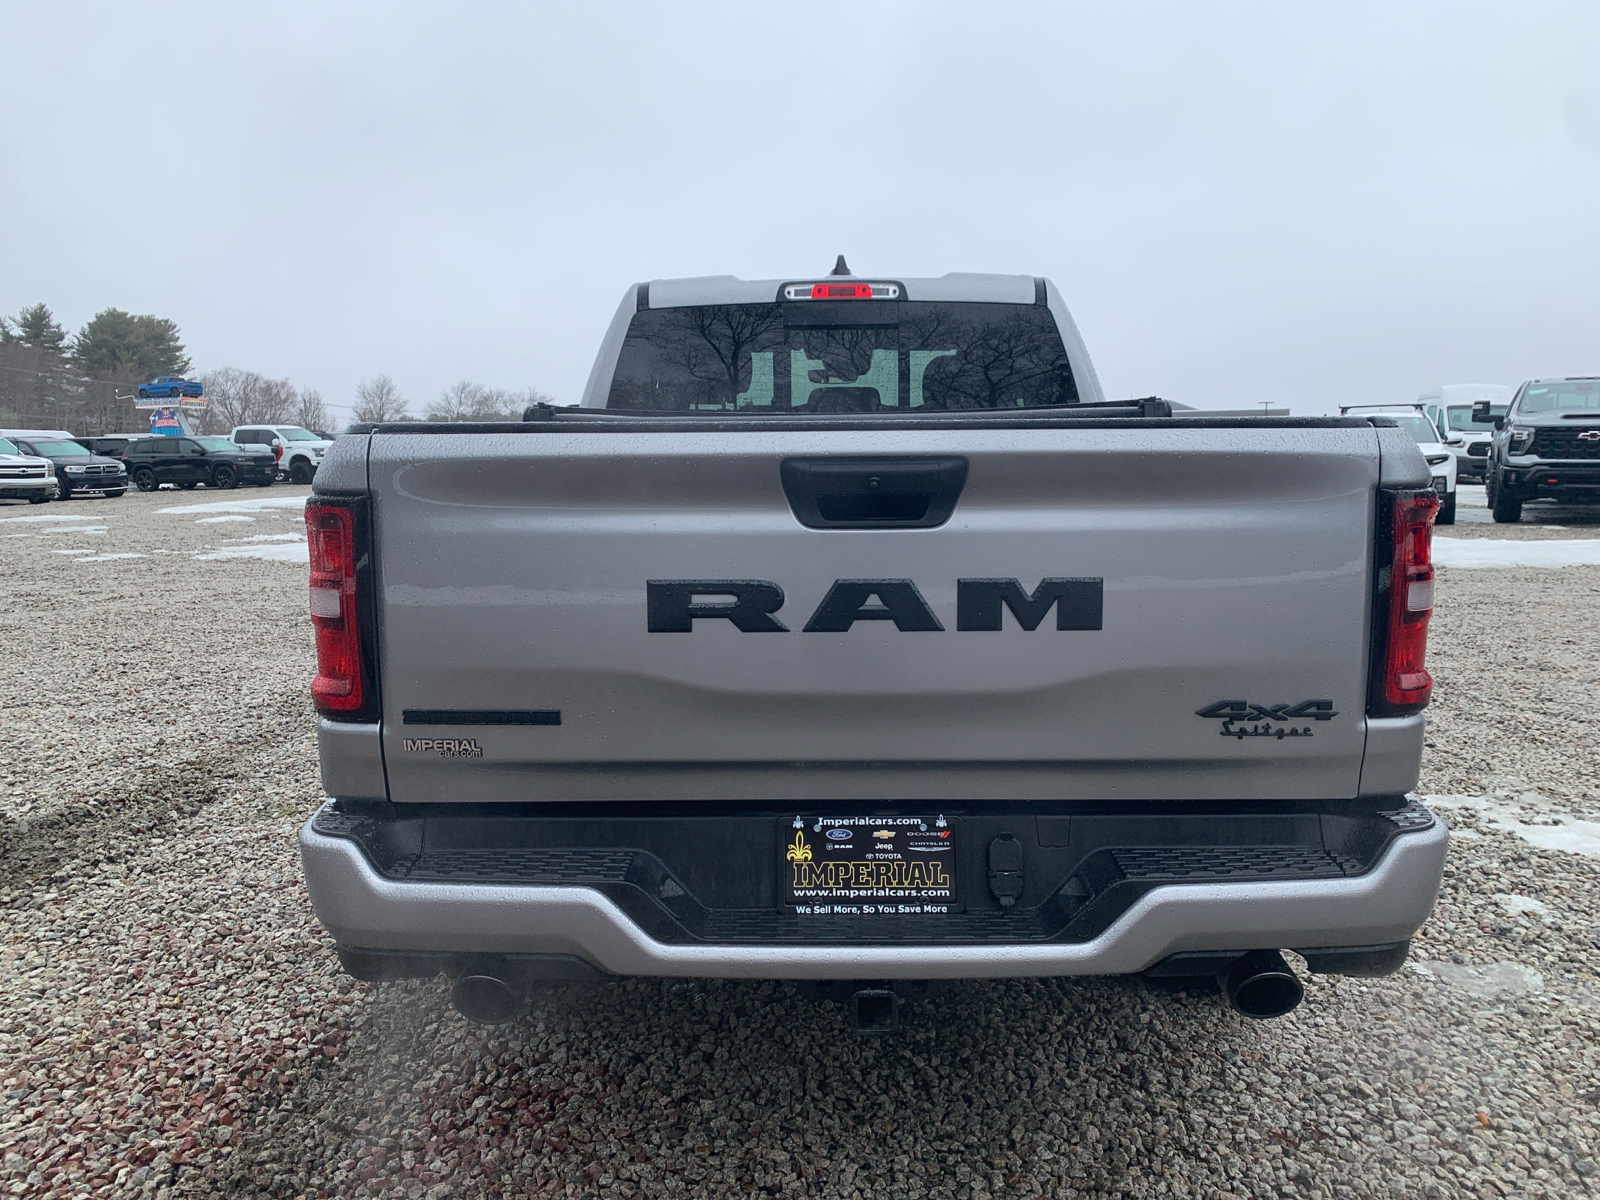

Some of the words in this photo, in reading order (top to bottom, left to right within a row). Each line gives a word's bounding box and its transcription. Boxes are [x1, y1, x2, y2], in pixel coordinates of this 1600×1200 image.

[647, 578, 1103, 632] RAM
[1195, 699, 1339, 721] 4x4
[403, 738, 482, 751] IMPERIAL
[439, 750, 482, 758] cars.com
[818, 817, 922, 827] Imperialcars.com
[793, 861, 949, 887] IMPERIAL
[793, 888, 950, 898] www.imperialcars.com
[796, 905, 811, 914] We
[813, 905, 831, 914] Sell
[834, 905, 861, 915] More,
[863, 905, 875, 913] So
[878, 905, 895, 913] You
[898, 905, 921, 913] Save
[924, 905, 947, 913] More
